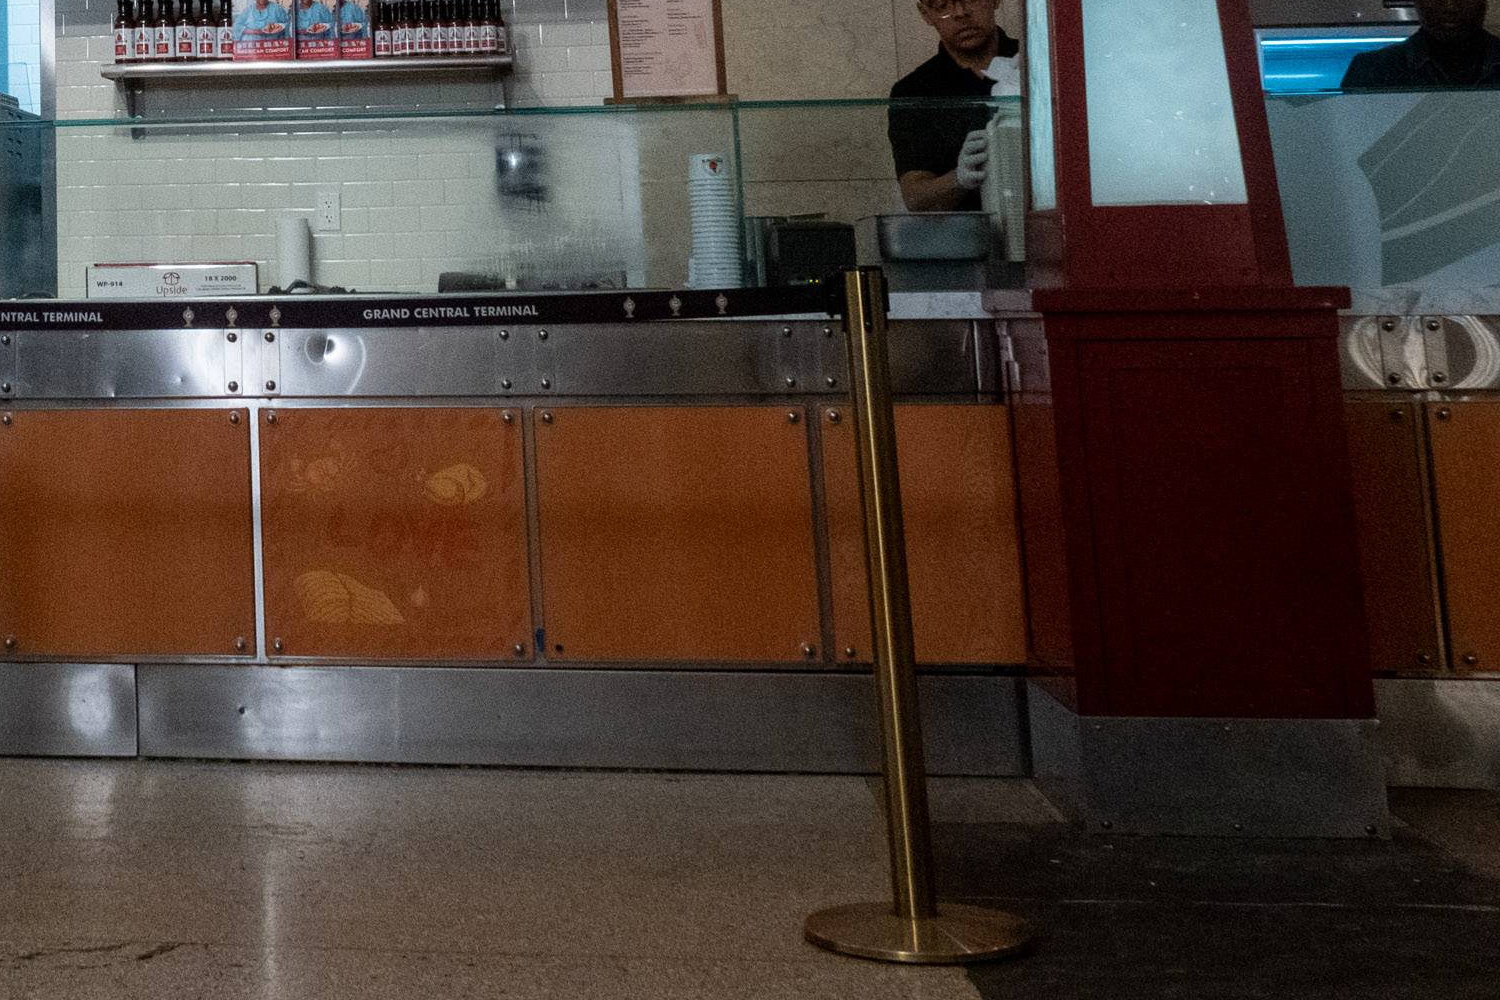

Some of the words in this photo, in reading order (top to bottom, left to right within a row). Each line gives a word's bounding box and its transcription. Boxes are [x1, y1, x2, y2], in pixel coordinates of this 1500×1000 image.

[156, 286, 187, 297] Upside
[43, 311, 103, 322] TERMINAL
[363, 308, 409, 320] GRAND
[414, 307, 470, 318] CENTRAL
[473, 304, 538, 316] TERMINAL
